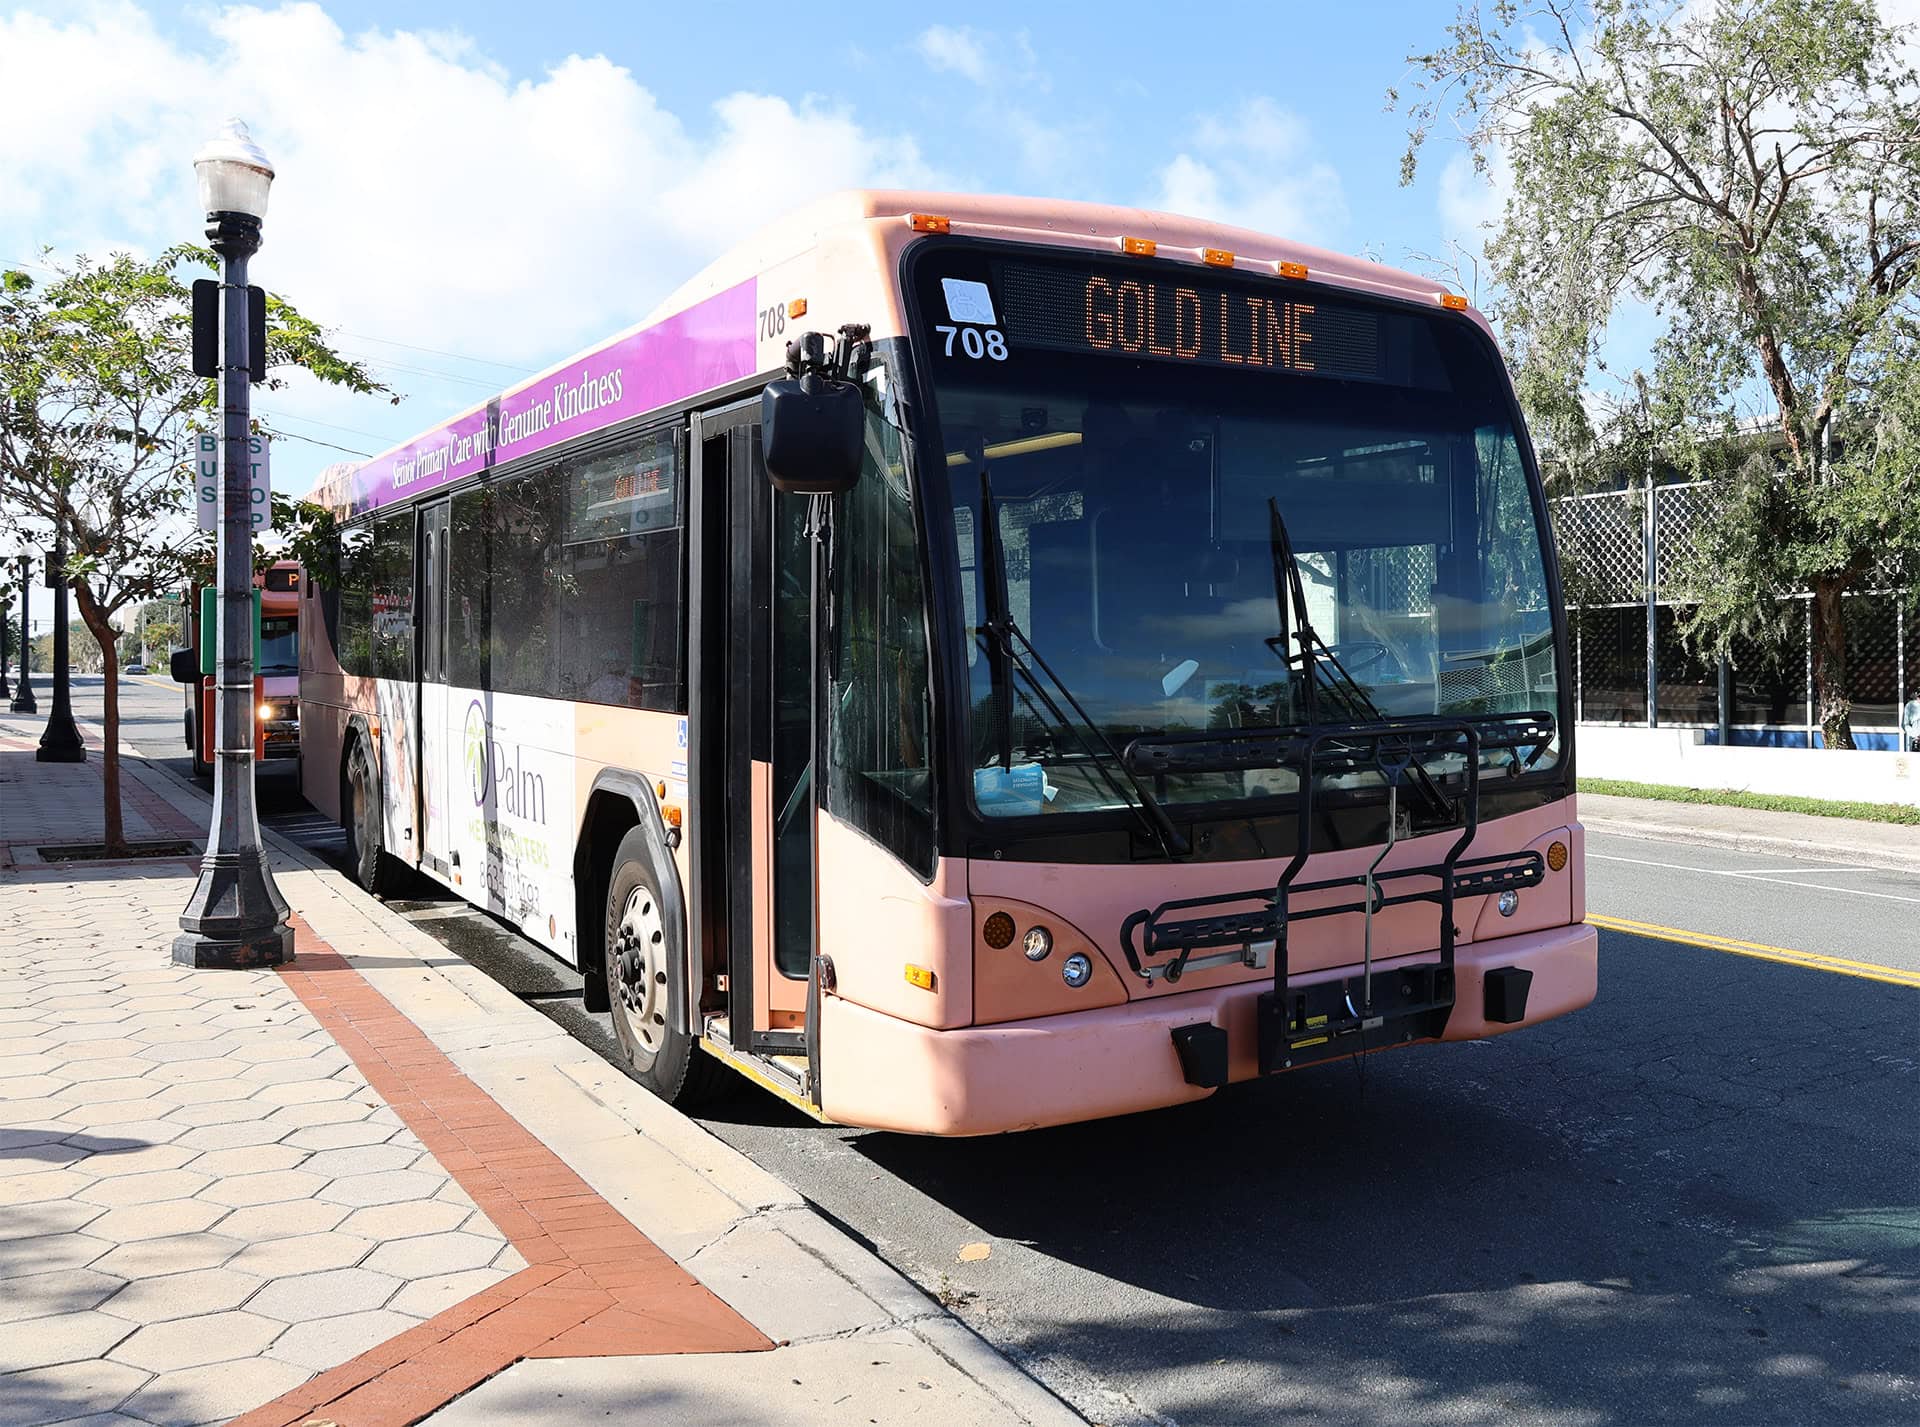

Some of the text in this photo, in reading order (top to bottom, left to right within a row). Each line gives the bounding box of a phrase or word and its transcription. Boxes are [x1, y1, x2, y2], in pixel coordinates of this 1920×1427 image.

[759, 302, 785, 342] 708
[935, 325, 1009, 361] 708
[1086, 276, 1316, 370] GOLD LINE
[200, 436, 217, 503] BUS
[392, 368, 623, 490] Senior Primary Care with Genuine Kindness
[249, 437, 265, 528] STOP
[491, 741, 546, 825] Palm
